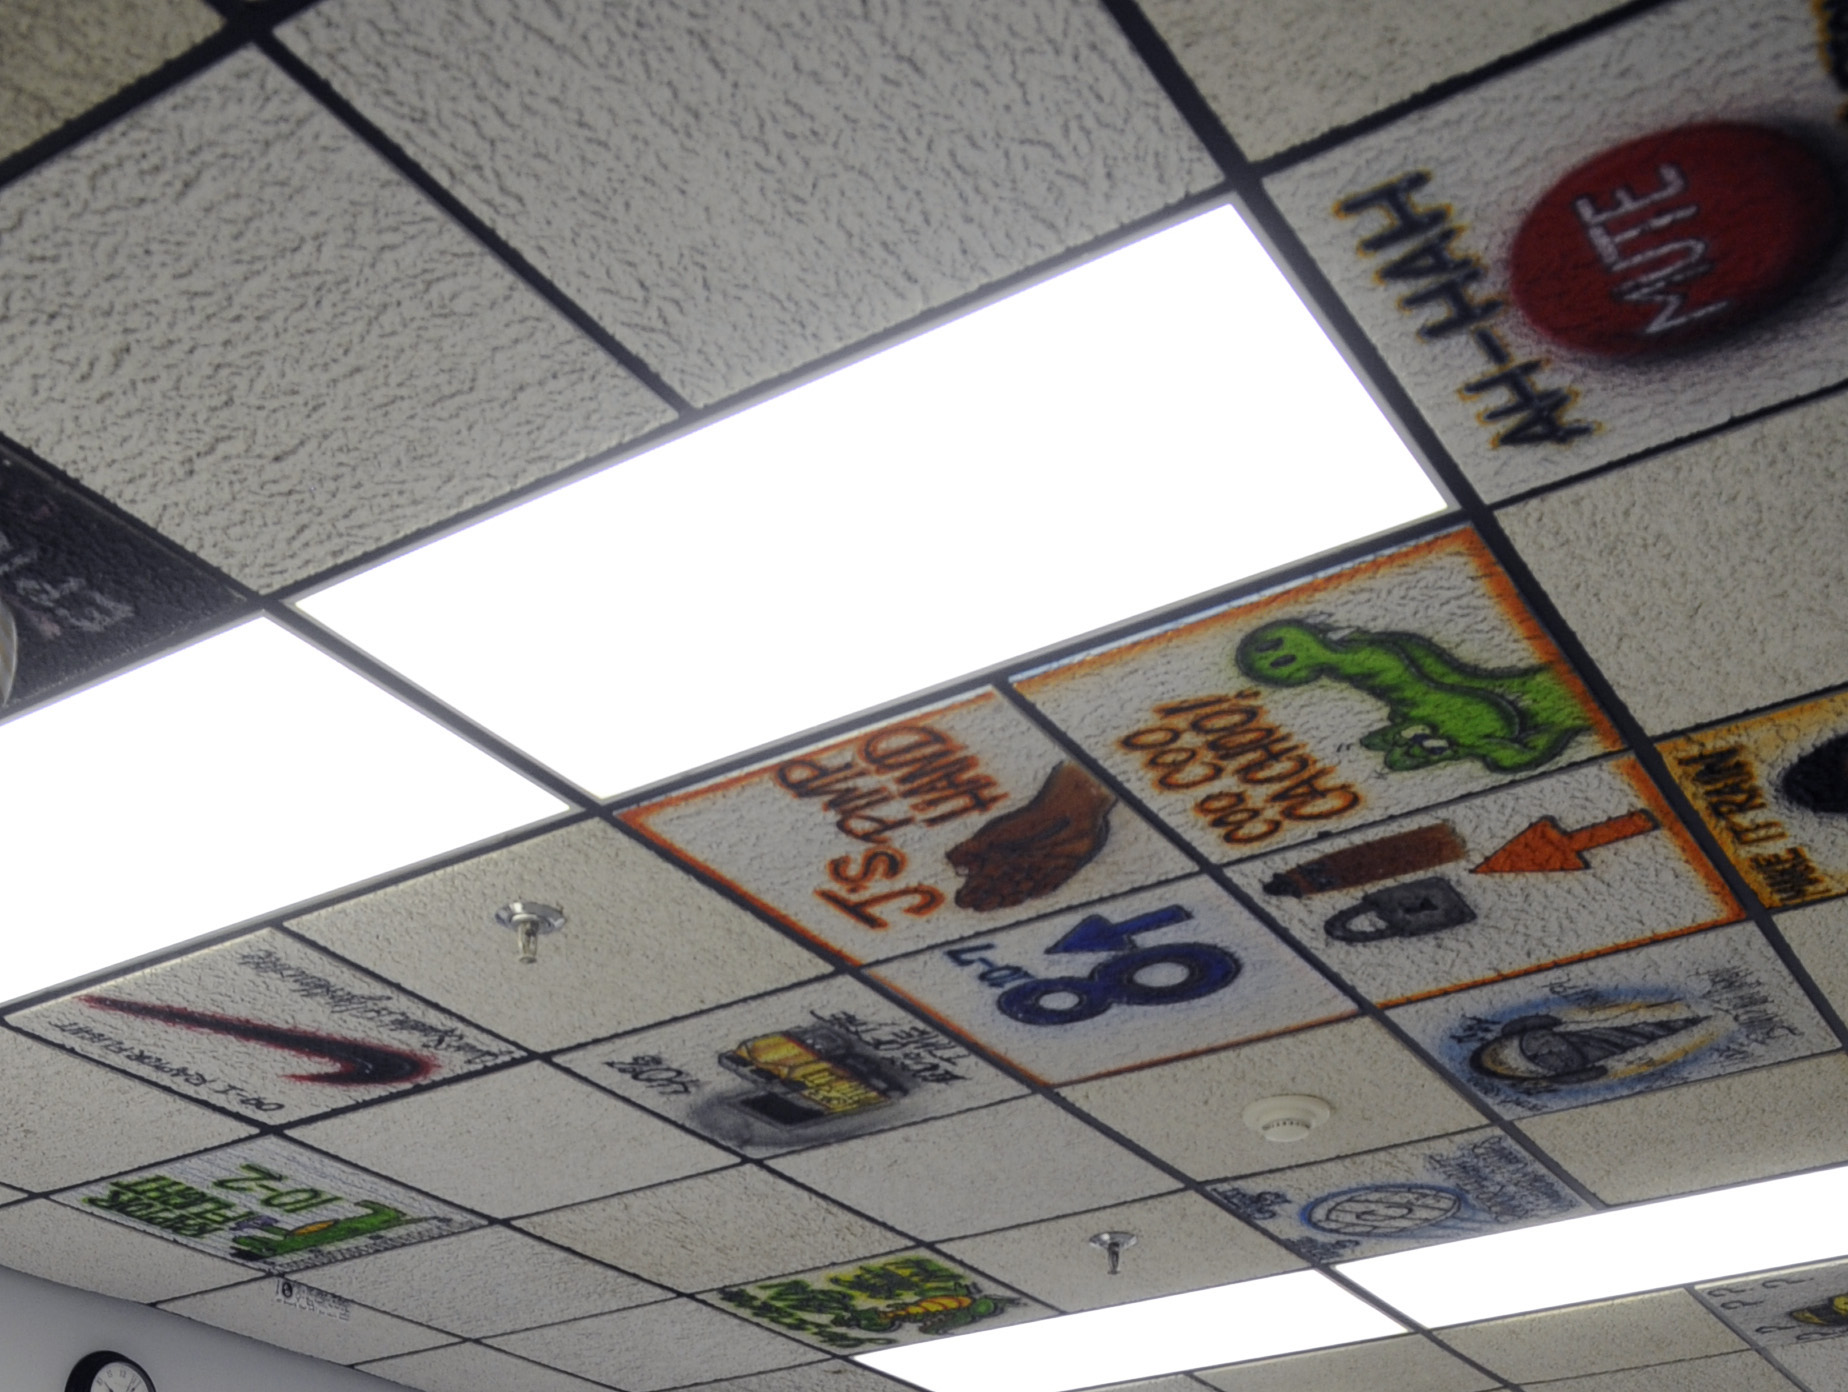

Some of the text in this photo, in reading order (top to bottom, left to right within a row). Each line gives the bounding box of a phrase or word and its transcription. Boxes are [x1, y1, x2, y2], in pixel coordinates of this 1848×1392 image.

[1572, 162, 1729, 335] MUTE
[774, 755, 914, 844] PIMP
[860, 725, 1007, 828] HAND
[1117, 725, 1281, 845] COO COO
[1677, 746, 1767, 819] RAIN
[214, 1164, 345, 1213] 10-2
